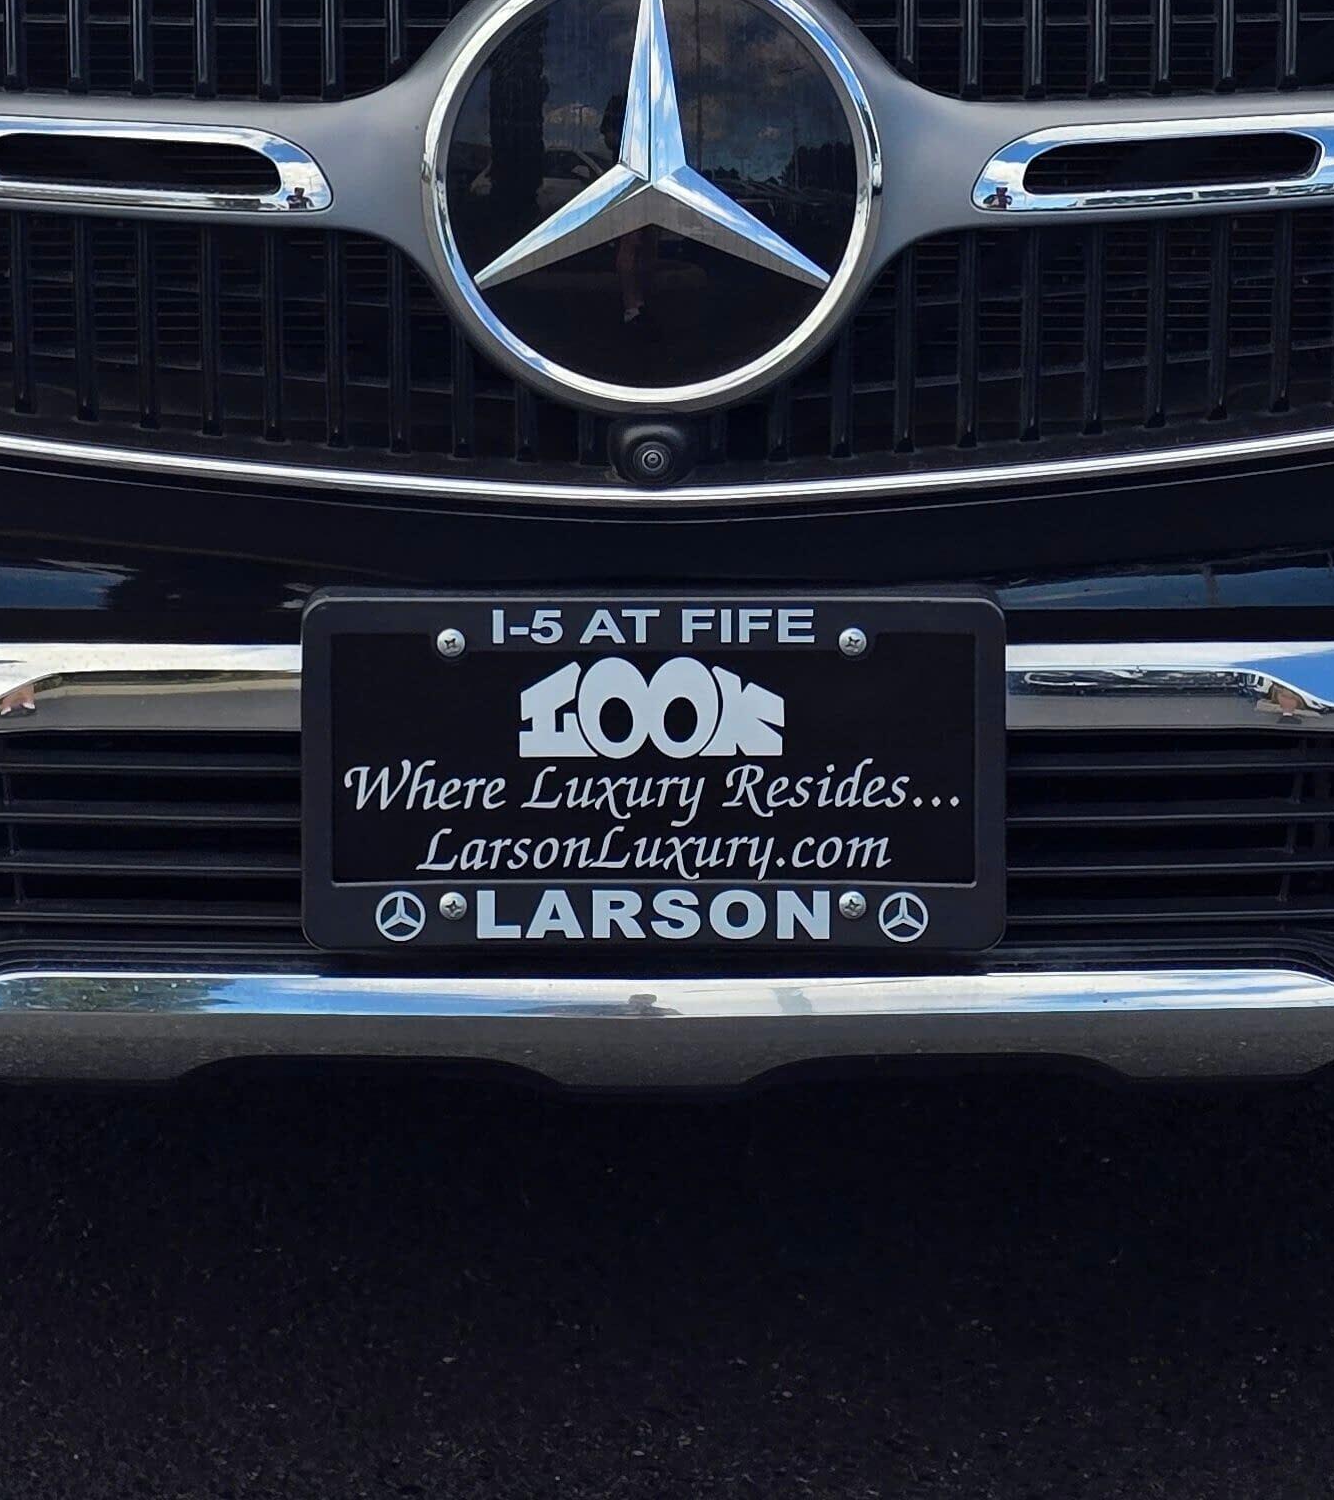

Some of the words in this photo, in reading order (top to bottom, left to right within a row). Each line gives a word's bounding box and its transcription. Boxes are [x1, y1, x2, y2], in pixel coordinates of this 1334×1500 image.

[493, 609, 564, 643] I-5
[580, 609, 661, 643] AT
[681, 609, 815, 643] FIFE
[519, 657, 785, 759] LOOK
[344, 759, 506, 811] Where
[520, 766, 706, 828] Luxury
[721, 757, 960, 818] Resides...
[416, 825, 892, 881] LarsonLuxury.com
[476, 889, 831, 940] LARSON
